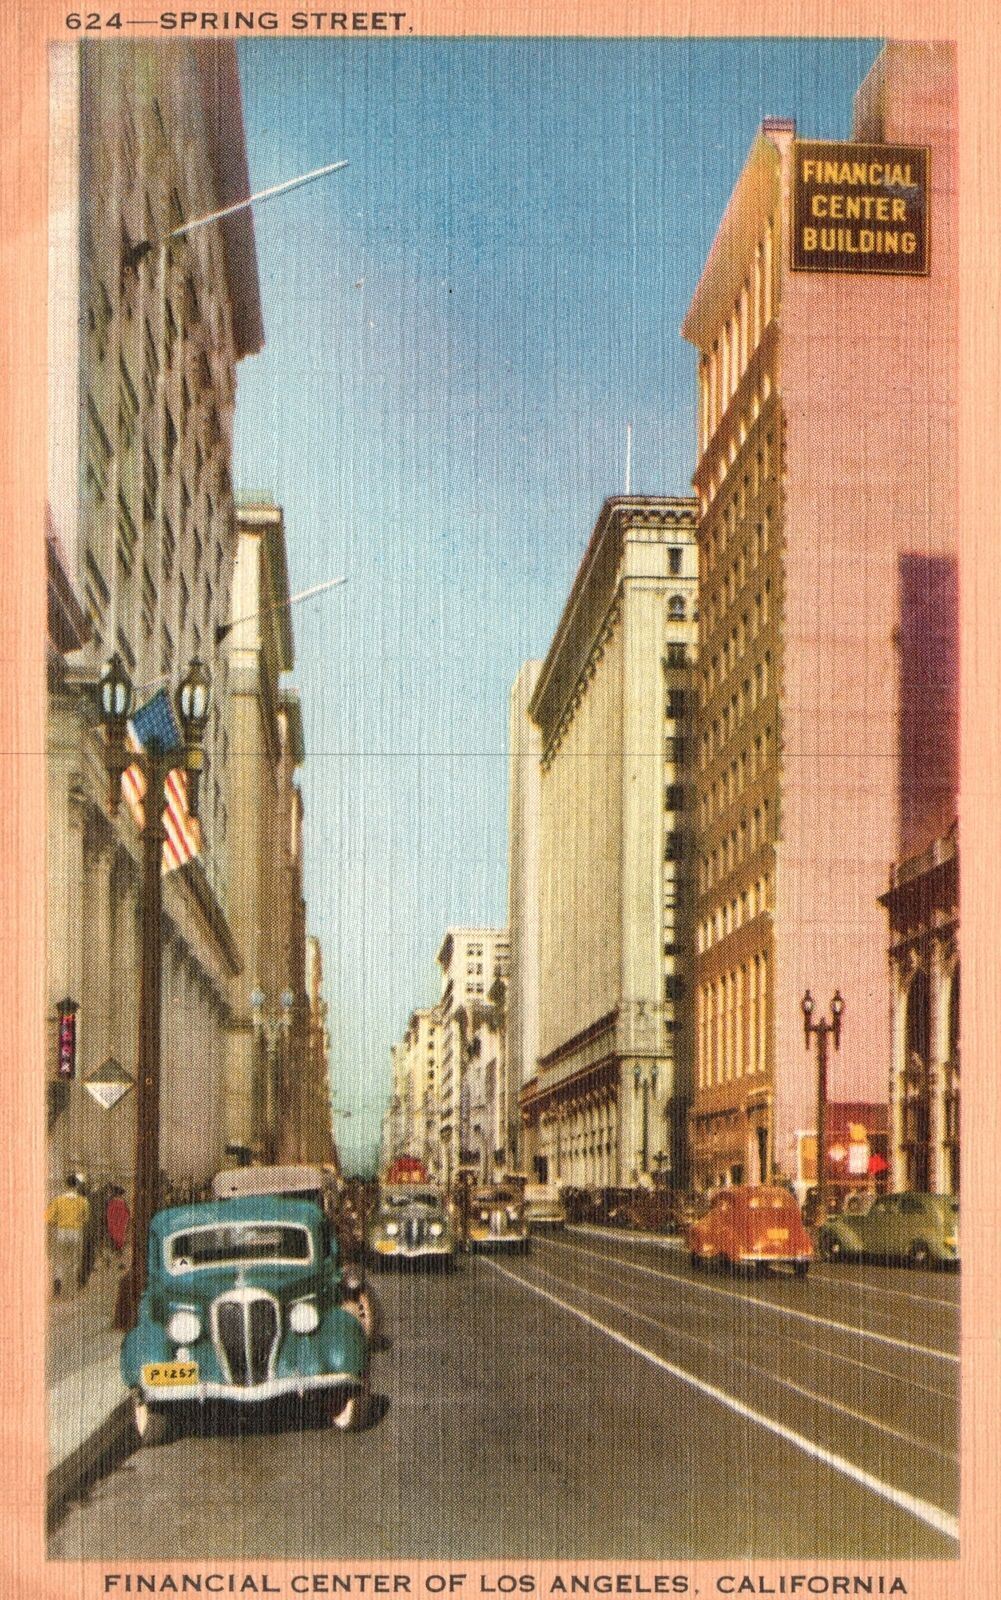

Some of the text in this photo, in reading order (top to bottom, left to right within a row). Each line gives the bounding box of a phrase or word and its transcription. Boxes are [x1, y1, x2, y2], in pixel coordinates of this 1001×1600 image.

[803, 160, 918, 188] FINANCIAL
[812, 194, 906, 222] CENTER
[803, 227, 917, 254] BUILDING
